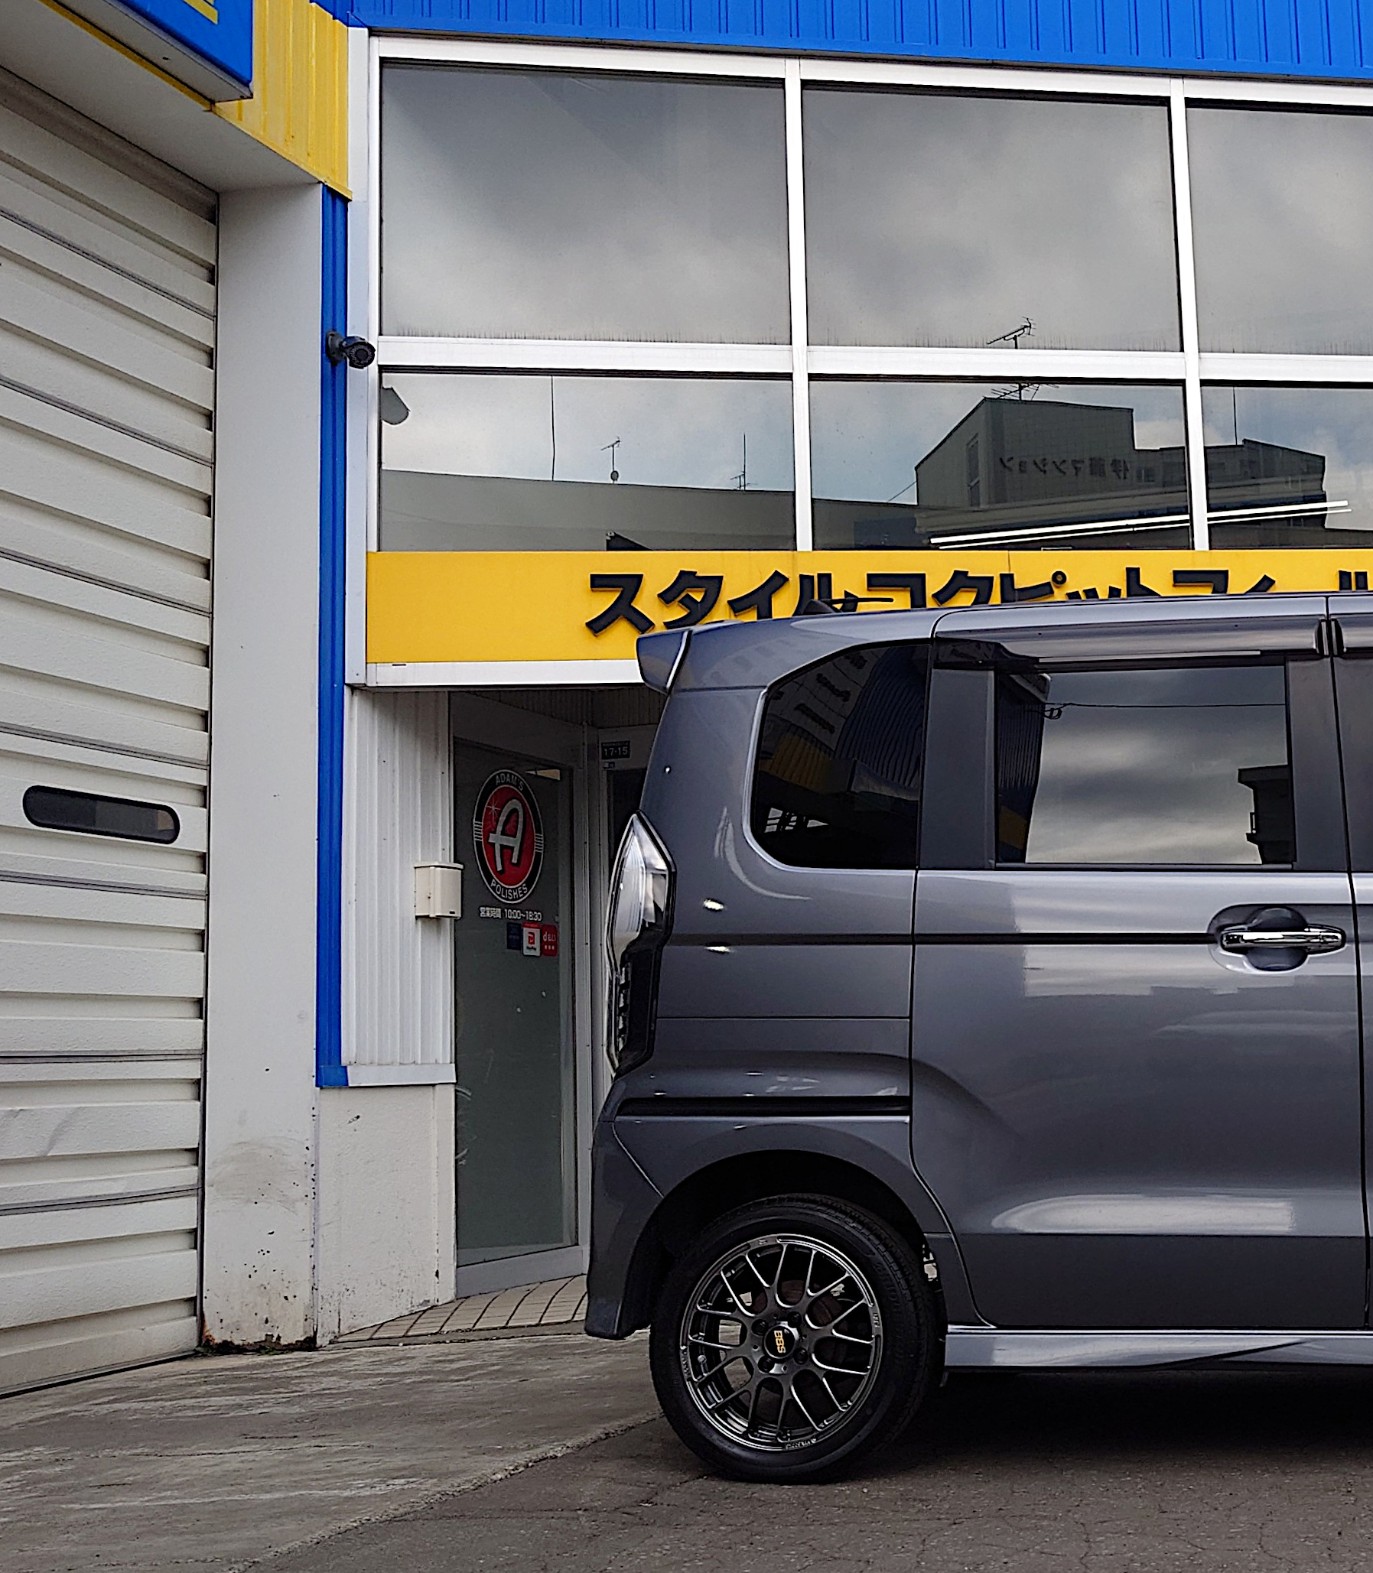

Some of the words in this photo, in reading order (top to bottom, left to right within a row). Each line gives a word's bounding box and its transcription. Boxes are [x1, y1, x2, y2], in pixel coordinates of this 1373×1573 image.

[495, 774, 525, 791] ADAM'S
[490, 878, 528, 900] POLISHES
[773, 1330, 786, 1354] BBS
